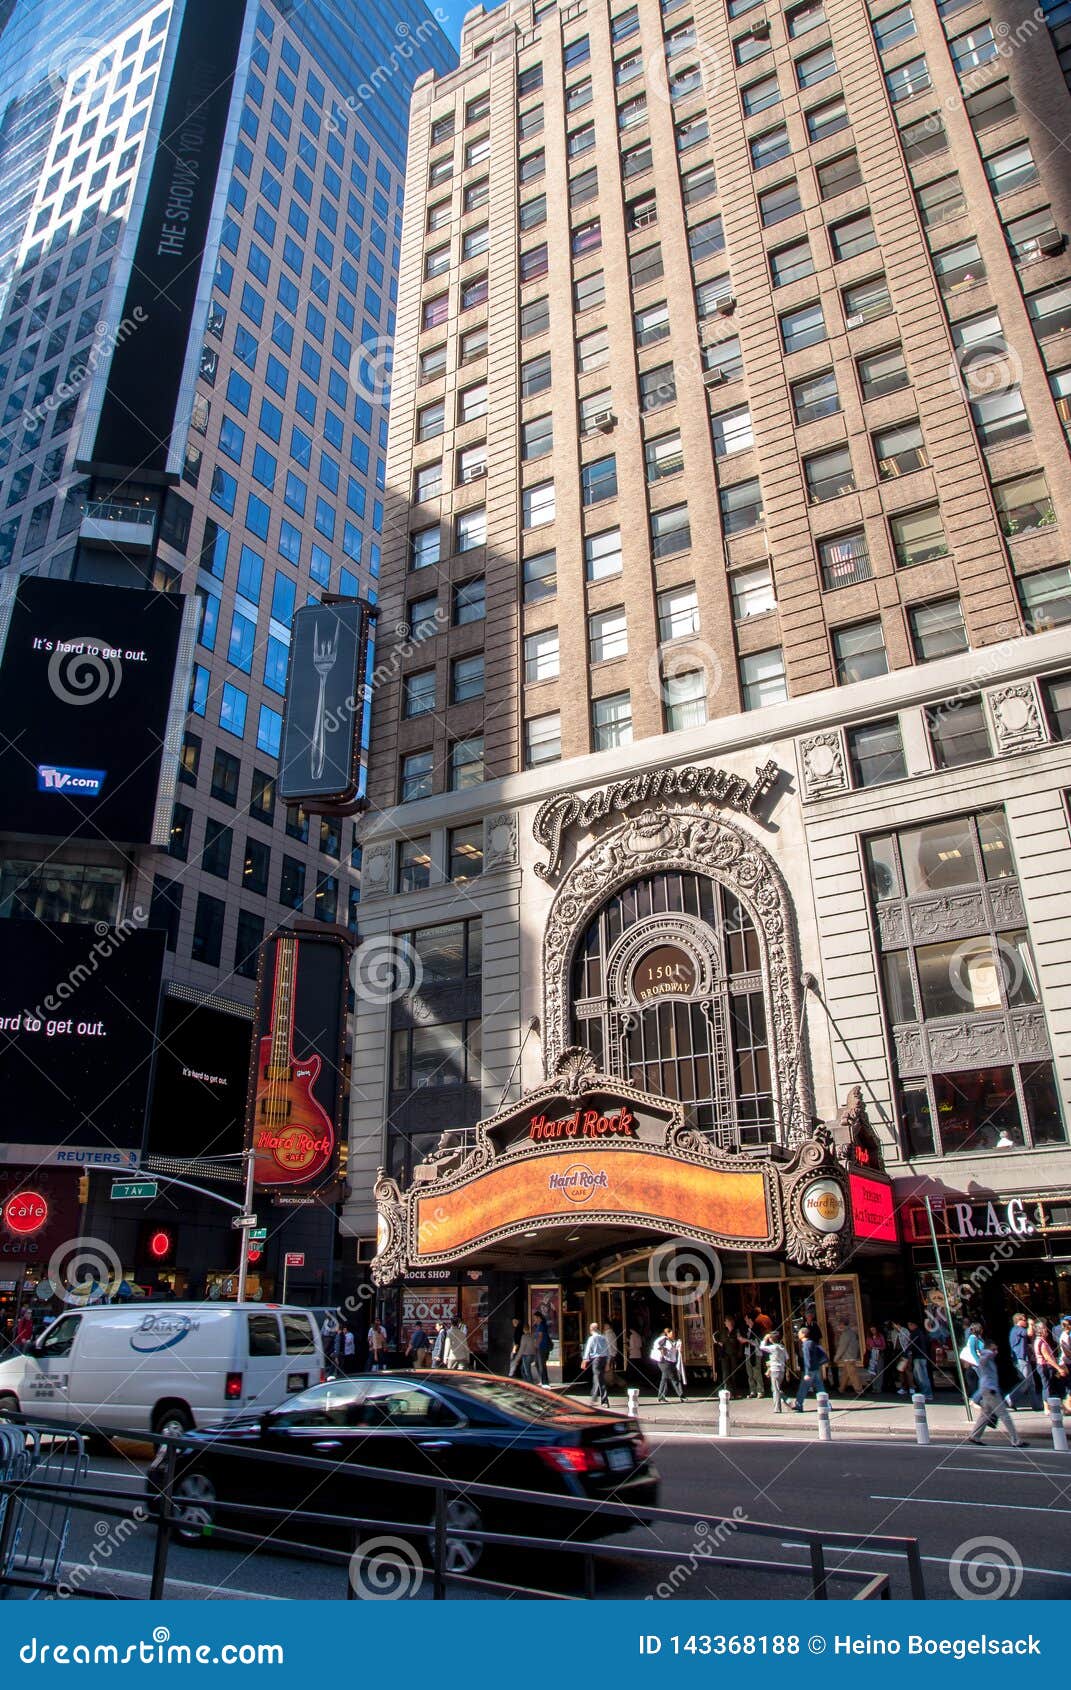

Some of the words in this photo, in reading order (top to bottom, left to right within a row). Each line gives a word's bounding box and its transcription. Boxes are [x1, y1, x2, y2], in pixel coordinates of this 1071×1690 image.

[165, 157, 199, 222] SHOWS
[157, 223, 186, 255] THE
[33, 637, 53, 651] It's
[56, 640, 83, 655] hard
[86, 644, 99, 656] to
[102, 646, 122, 661] get
[125, 649, 148, 661] out.
[533, 760, 780, 880] Paramount
[648, 964, 680, 980] 1501
[640, 983, 690, 999] BROADWAY
[26, 1017, 41, 1031] to
[46, 1019, 73, 1036] get
[77, 1021, 106, 1036] out.
[530, 1111, 580, 1138] Hard
[583, 1106, 633, 1139] Rock
[257, 1130, 295, 1149] Hard
[296, 1133, 330, 1155] Rock
[57, 1152, 121, 1163] REUTERS
[282, 1154, 304, 1162] CAFE
[549, 1172, 578, 1189] Hard
[579, 1170, 608, 1188] Rock
[124, 1187, 129, 1195] 7
[8, 1204, 44, 1217] cafe
[807, 1198, 828, 1208] Hard
[955, 1198, 1034, 1238] R.A.G.
[428, 1271, 451, 1279] SHOP
[402, 1303, 457, 1319] ROCK
